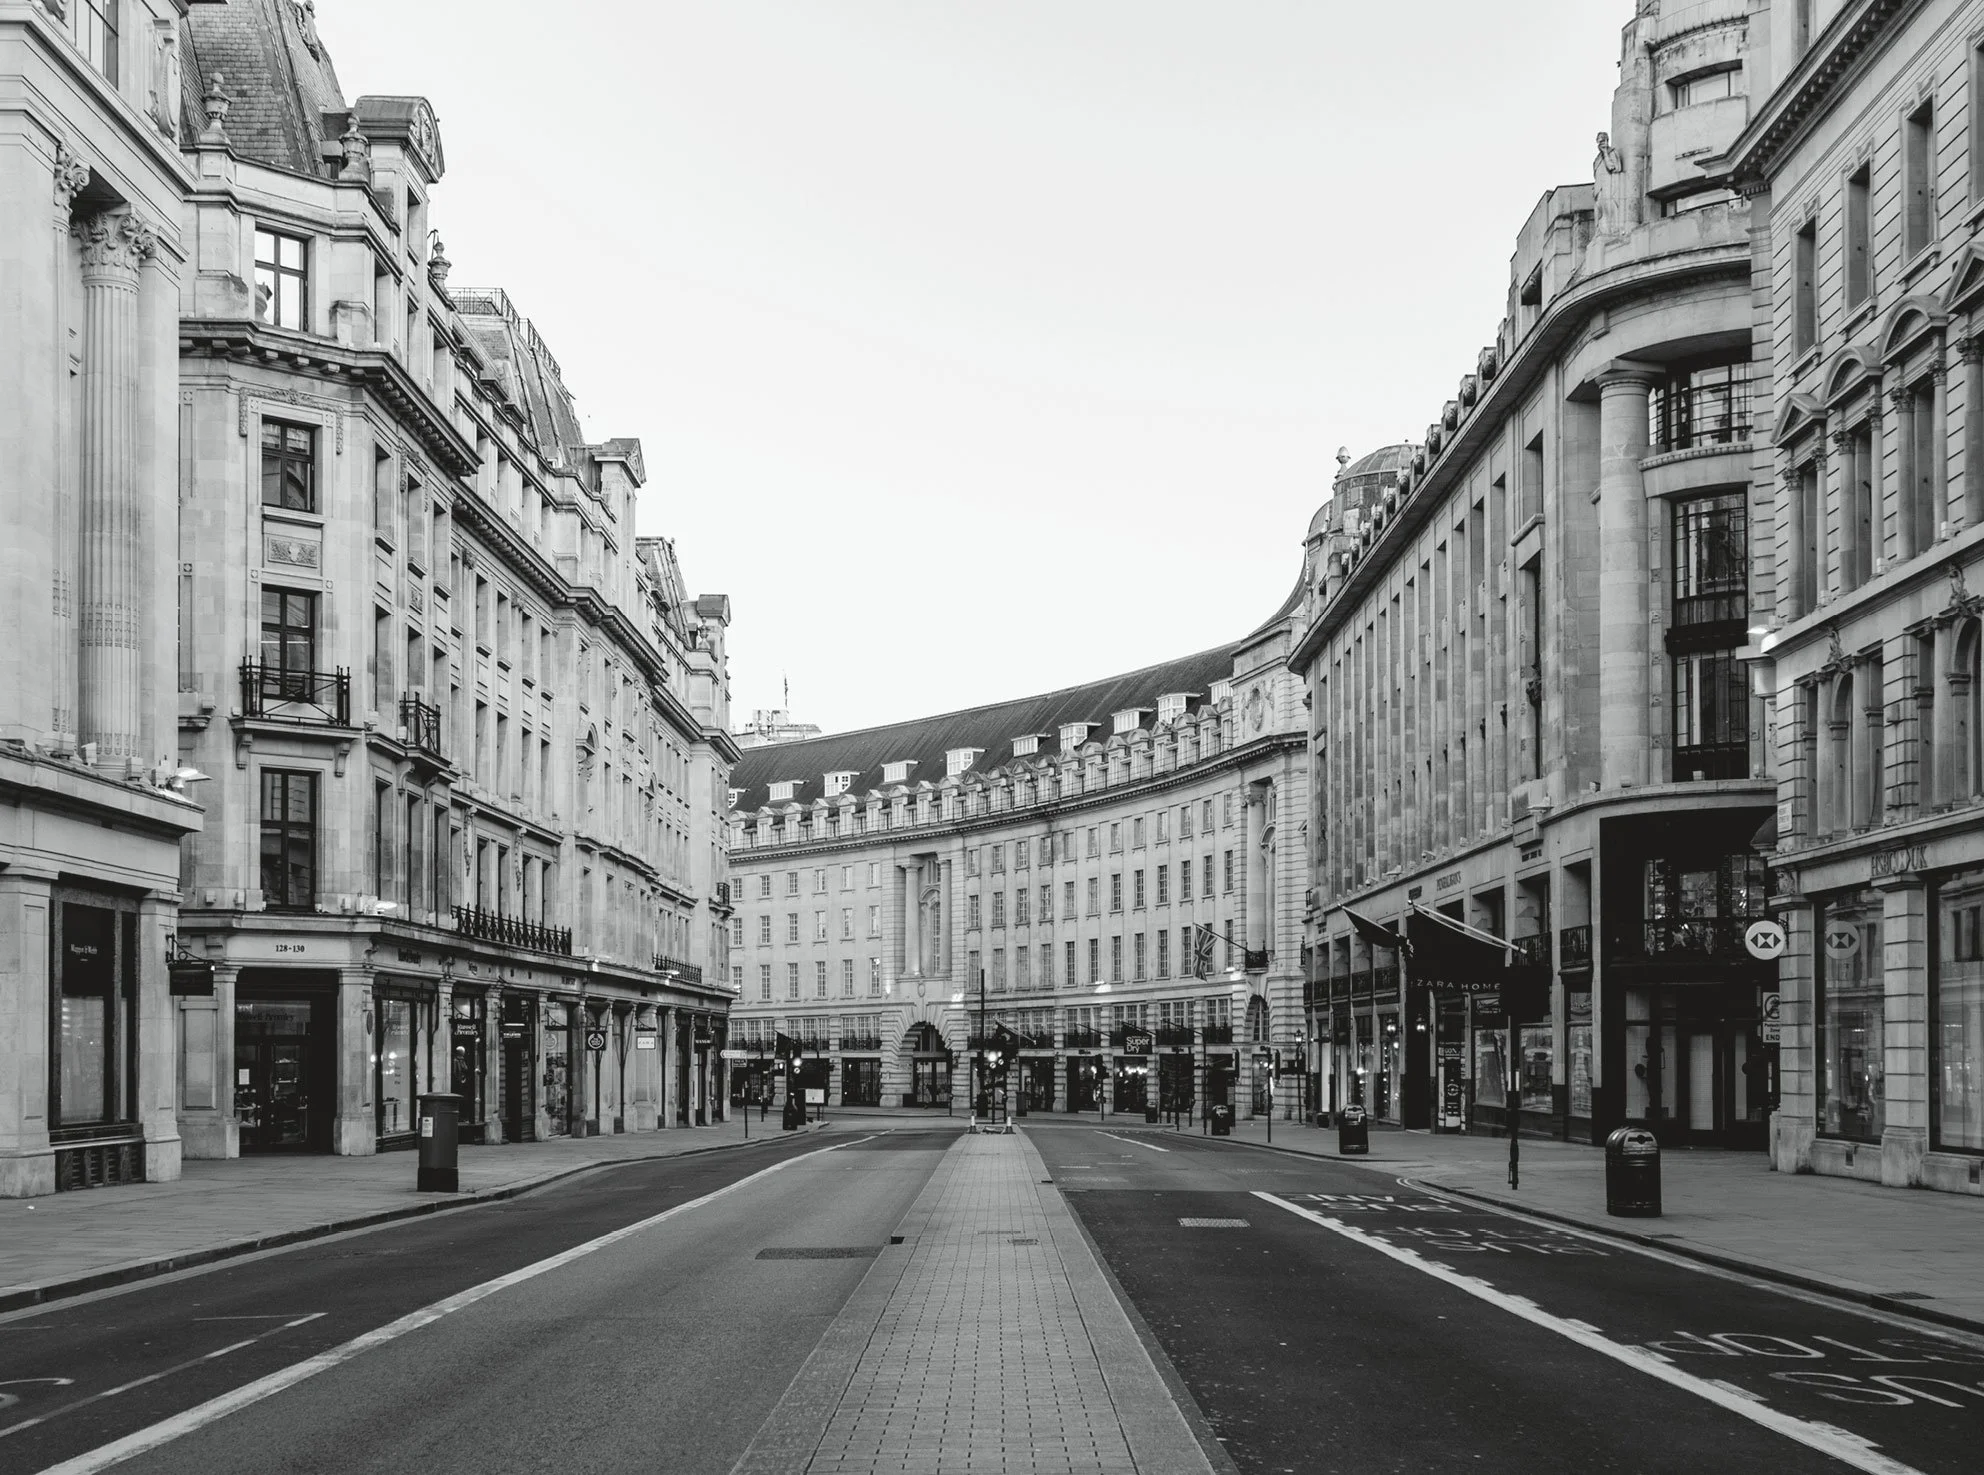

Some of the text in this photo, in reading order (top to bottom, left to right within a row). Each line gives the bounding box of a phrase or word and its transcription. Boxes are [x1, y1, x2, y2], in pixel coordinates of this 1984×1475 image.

[1871, 845, 1928, 877] HSBC UK
[275, 944, 305, 953] 128-130
[1417, 979, 1501, 991] ZARA HOME
[1126, 1036, 1150, 1047] Super
[1126, 1044, 1140, 1054] Dry
[1425, 1239, 1611, 1256] BUS
[1645, 1330, 1984, 1366] STOP
[1768, 1371, 1984, 1408] US
